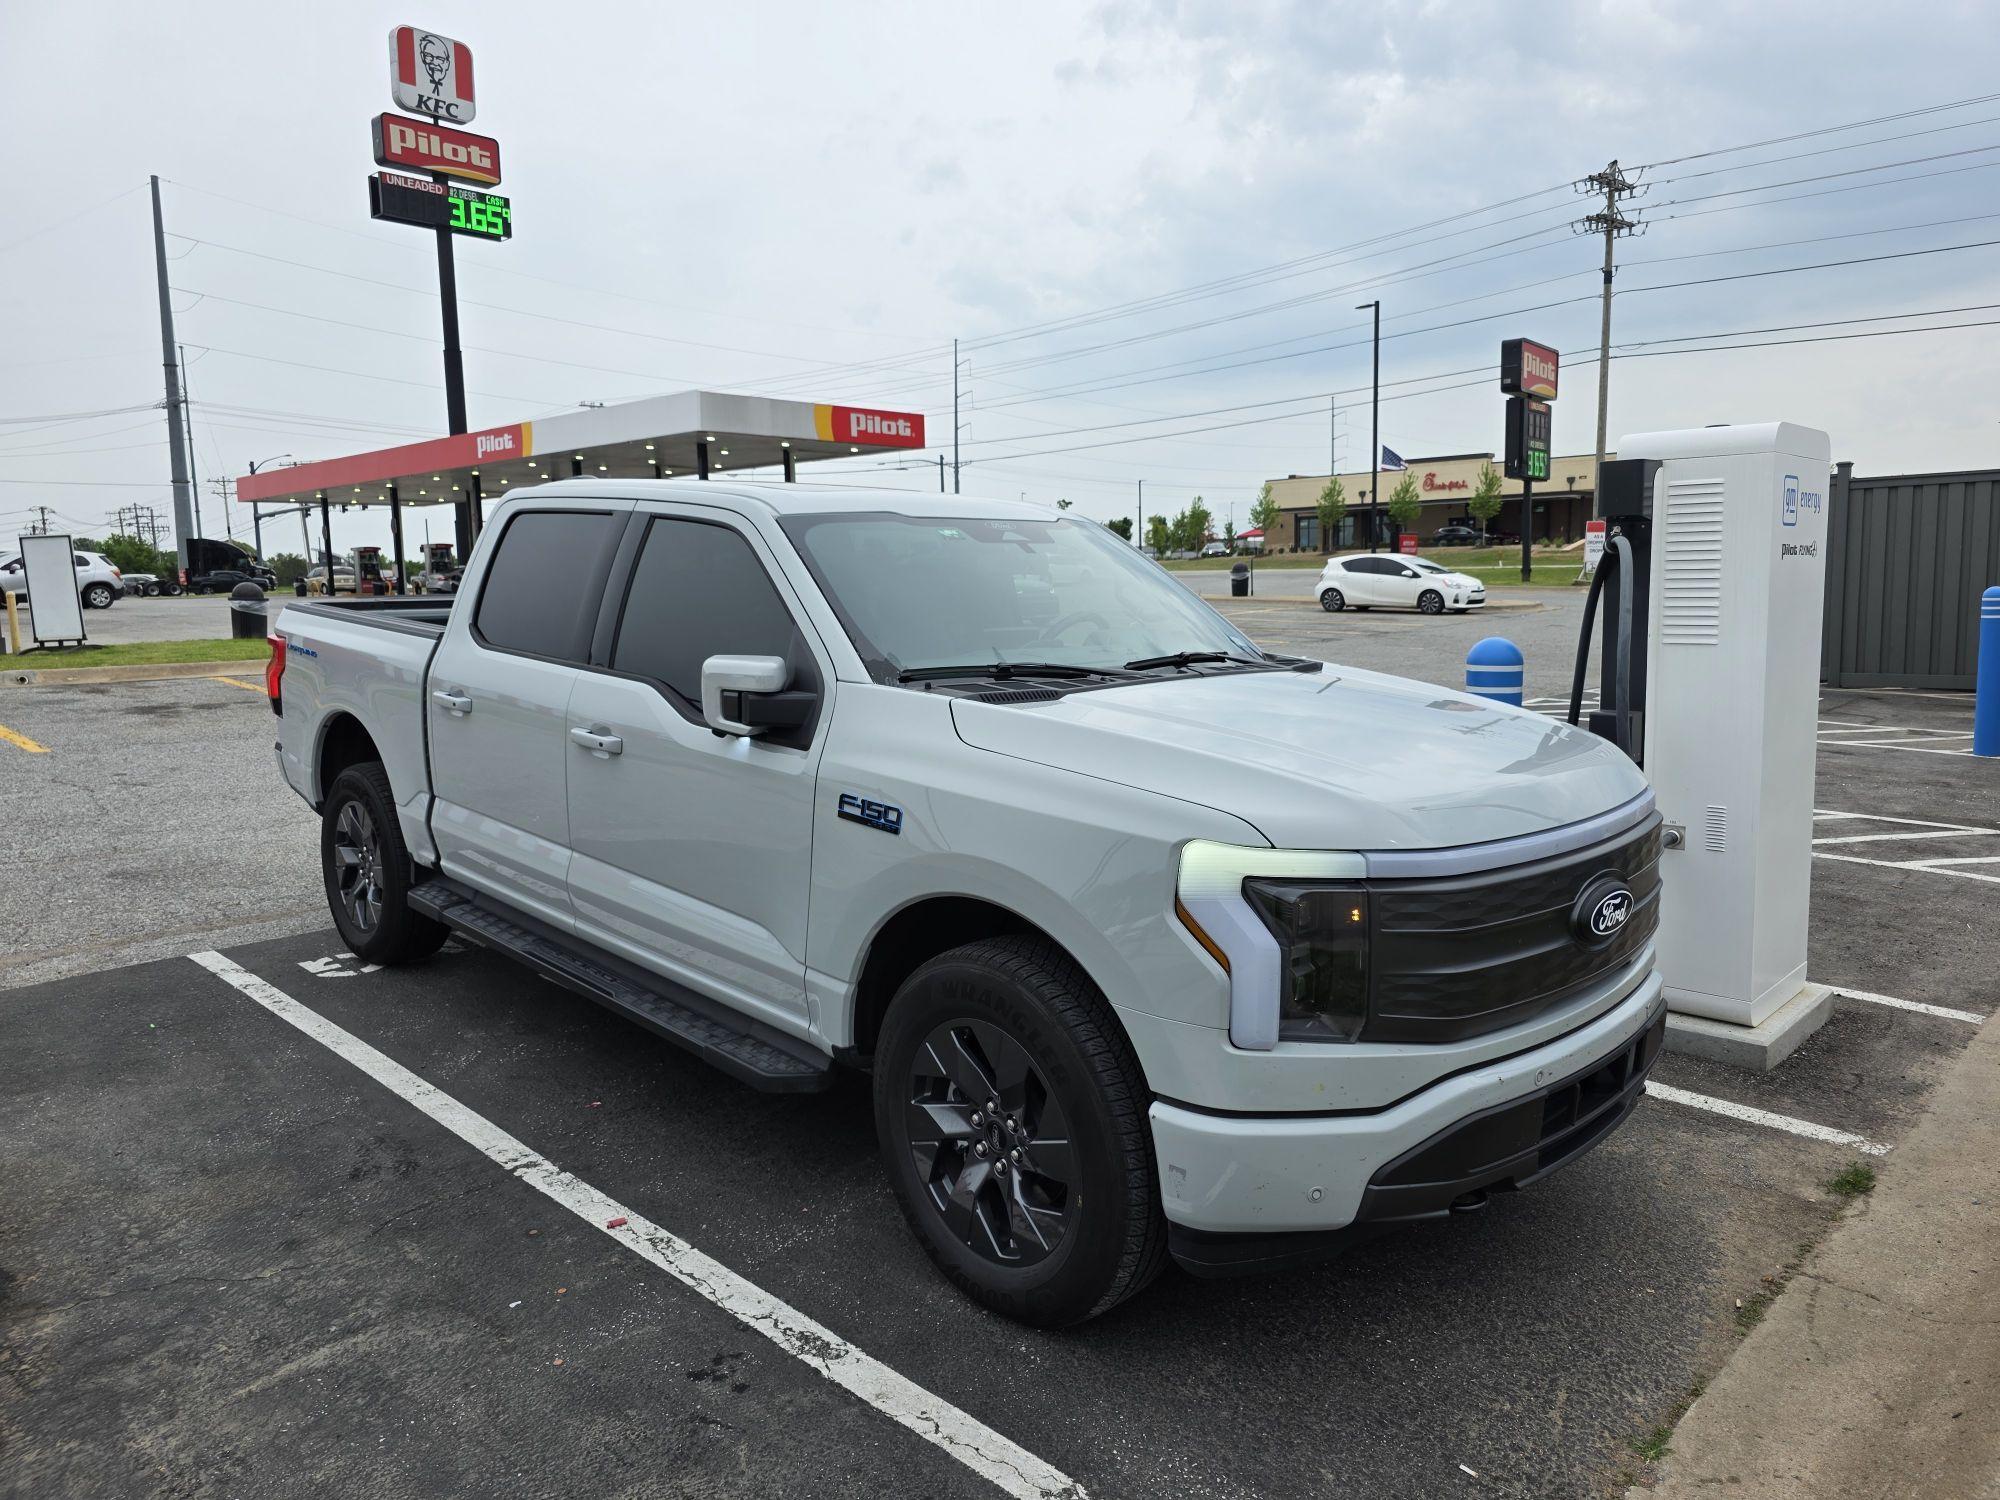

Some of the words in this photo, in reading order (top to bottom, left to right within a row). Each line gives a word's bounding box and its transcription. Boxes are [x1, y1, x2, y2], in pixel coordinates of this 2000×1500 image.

[416, 94, 459, 118] KFC
[386, 174, 443, 194] UNLEADED
[459, 190, 479, 202] DIESEL
[486, 195, 505, 207] CASH
[1800, 491, 1822, 514] energy
[838, 793, 904, 829] F-150
[1599, 897, 1628, 930] Ford
